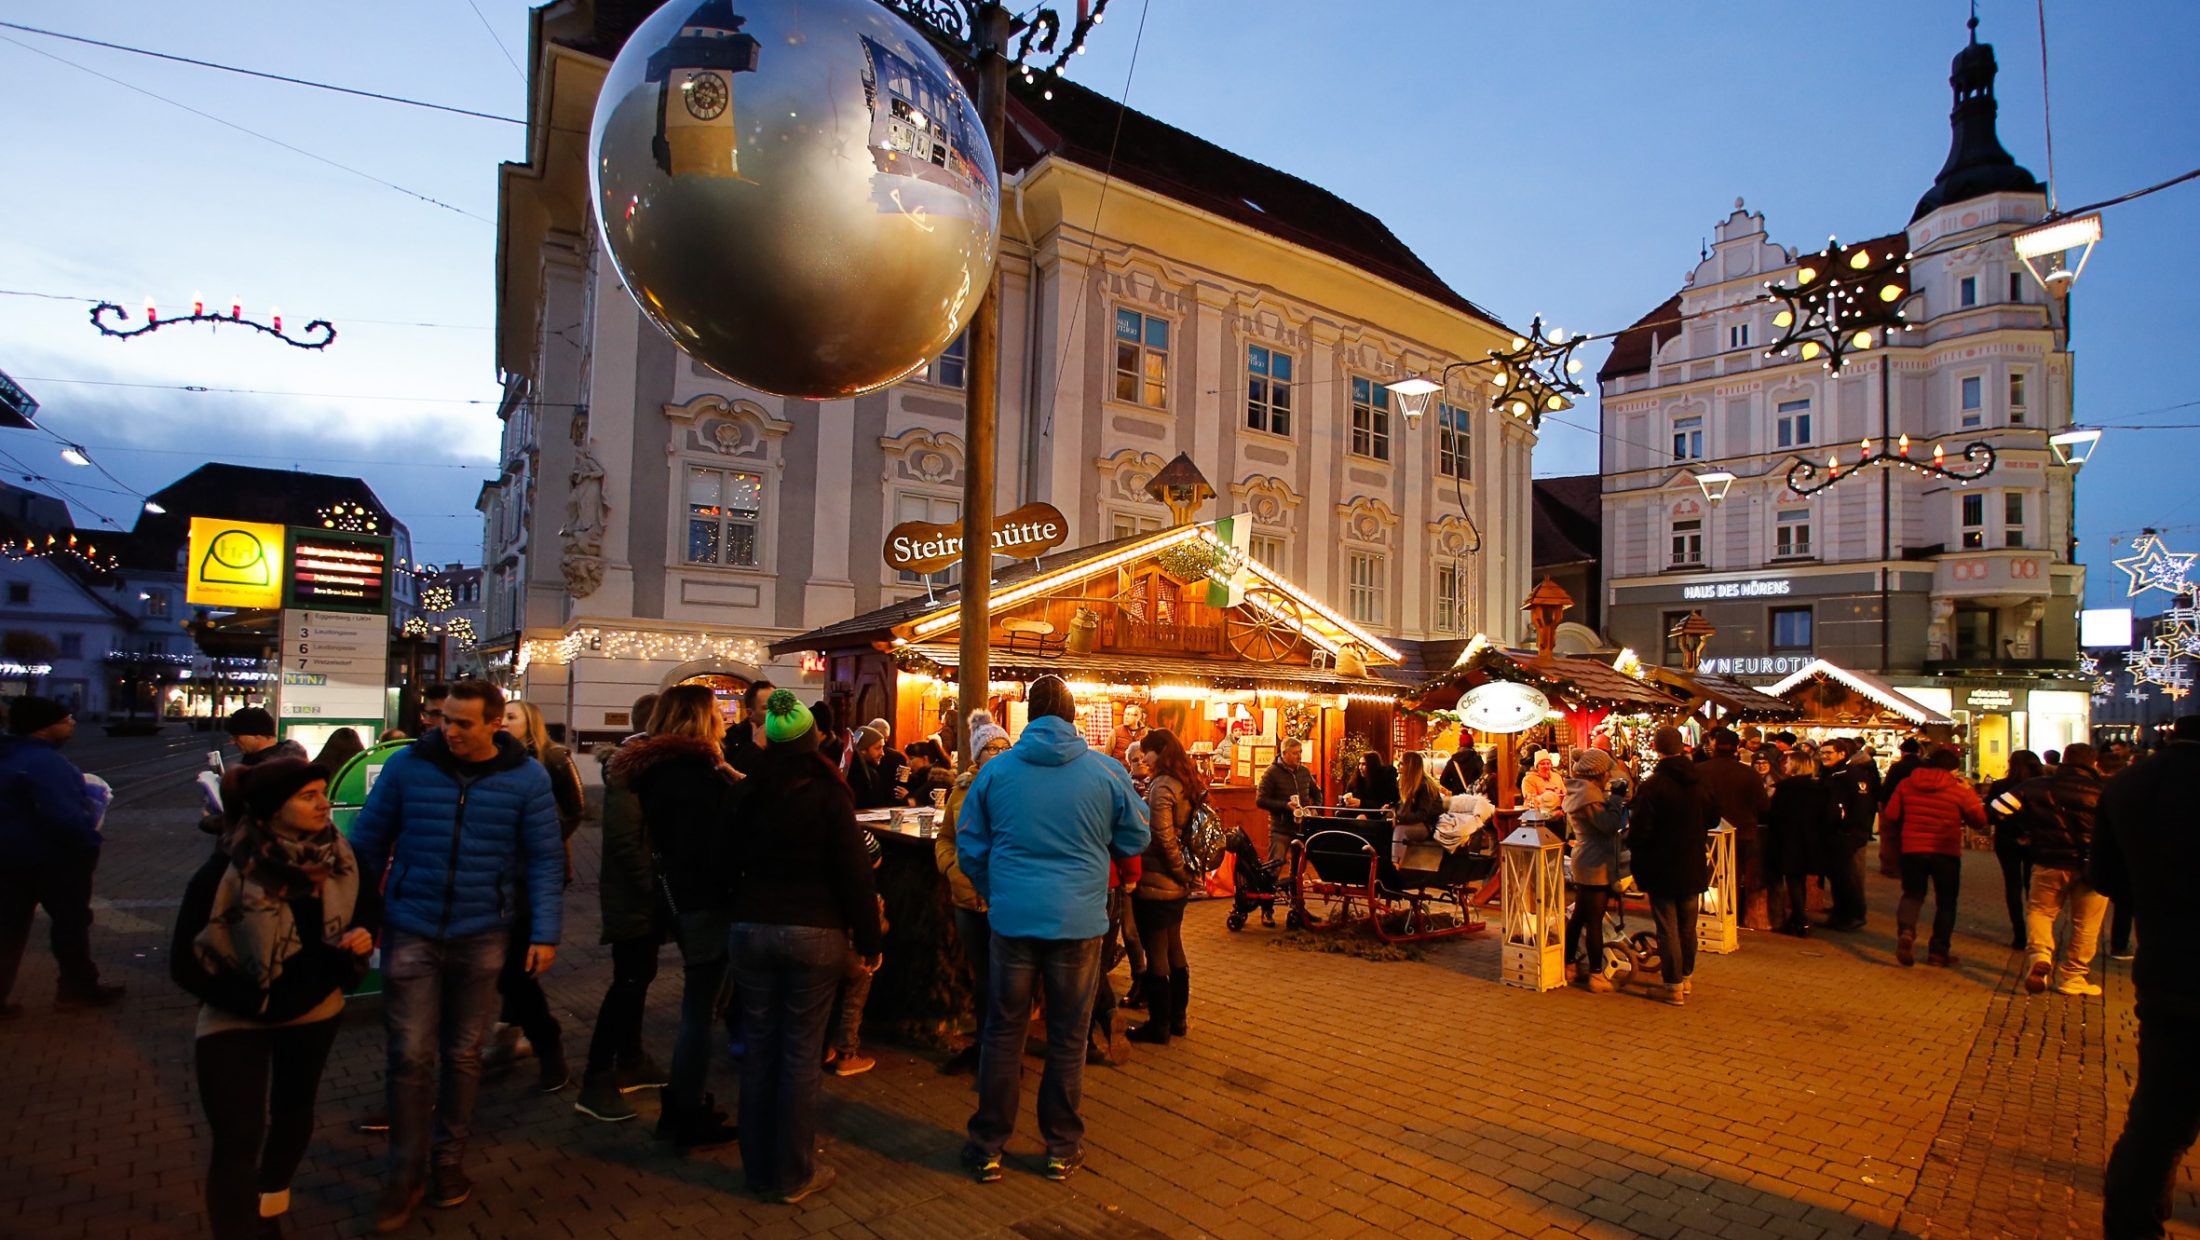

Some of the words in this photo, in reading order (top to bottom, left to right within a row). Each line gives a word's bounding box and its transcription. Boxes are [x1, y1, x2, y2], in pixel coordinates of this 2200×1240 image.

[1684, 585, 1715, 599] HAUS
[1717, 584, 1739, 597] DES
[1741, 580, 1790, 596] HÖRENS
[303, 613, 308, 621] 1
[300, 628, 309, 638] 3
[299, 644, 308, 654] 6
[298, 659, 307, 669] 7
